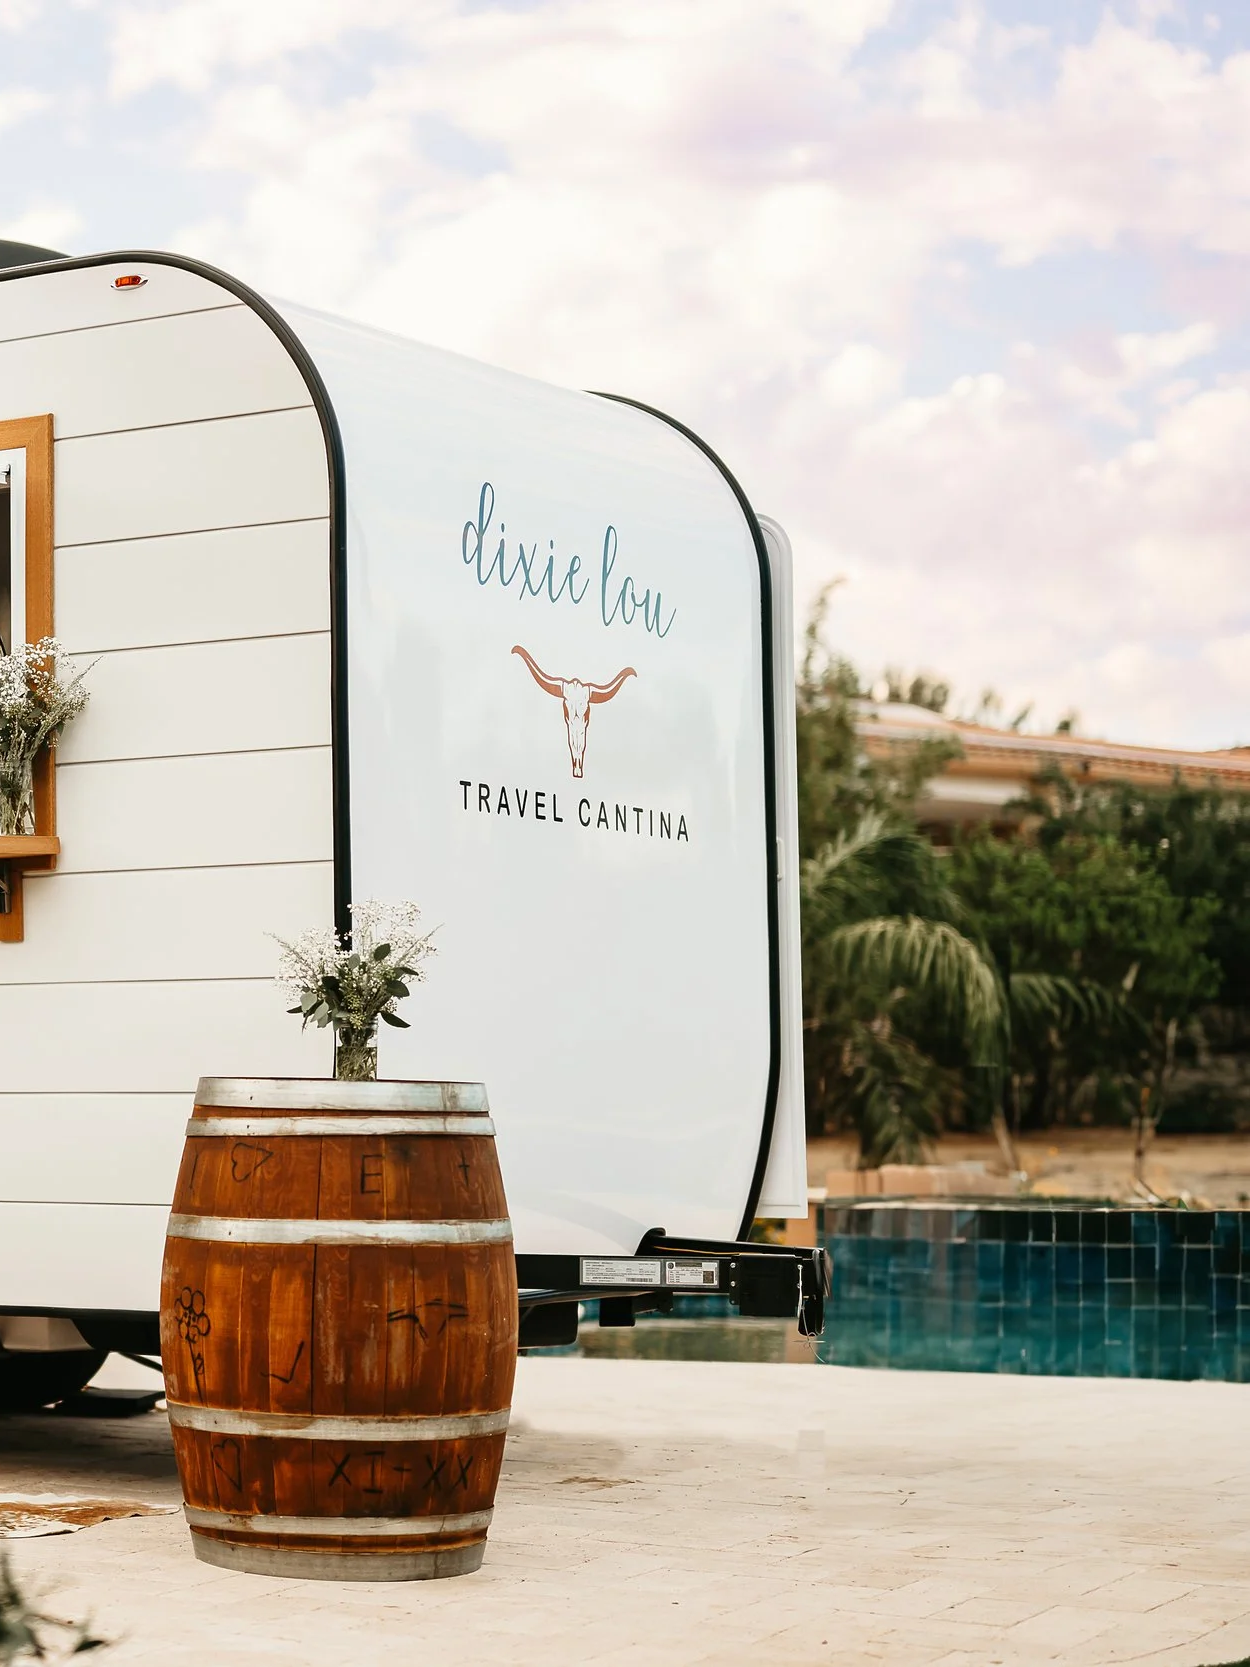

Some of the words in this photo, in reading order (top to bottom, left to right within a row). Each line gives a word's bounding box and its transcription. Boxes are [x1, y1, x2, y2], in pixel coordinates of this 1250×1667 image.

[461, 481, 590, 605] dixie
[600, 525, 677, 638] lou
[459, 780, 564, 823] TRAVEL
[578, 798, 689, 842] CANTINA
